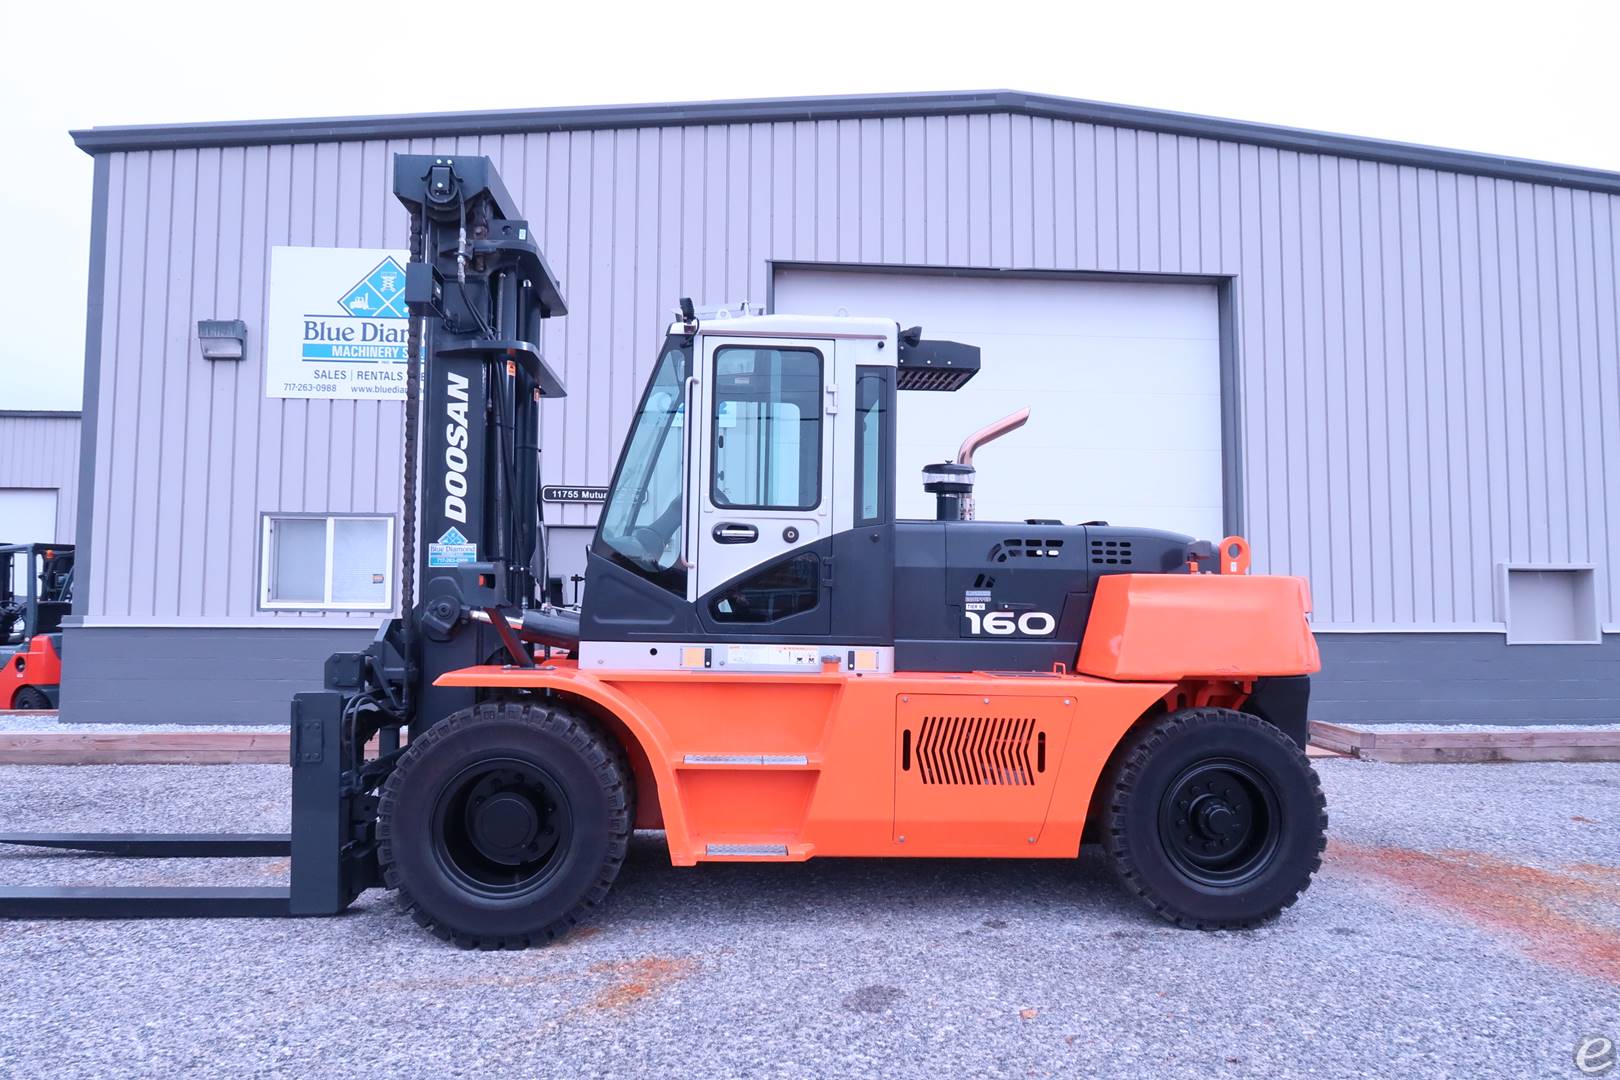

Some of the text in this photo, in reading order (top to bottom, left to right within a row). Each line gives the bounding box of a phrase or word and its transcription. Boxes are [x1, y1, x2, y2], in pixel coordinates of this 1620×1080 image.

[304, 321, 355, 341] Blue
[332, 345, 399, 358] MACHINERY
[314, 370, 404, 381] SALES RENTALS
[444, 372, 469, 524] DOOSAN
[966, 612, 1056, 635] 160
